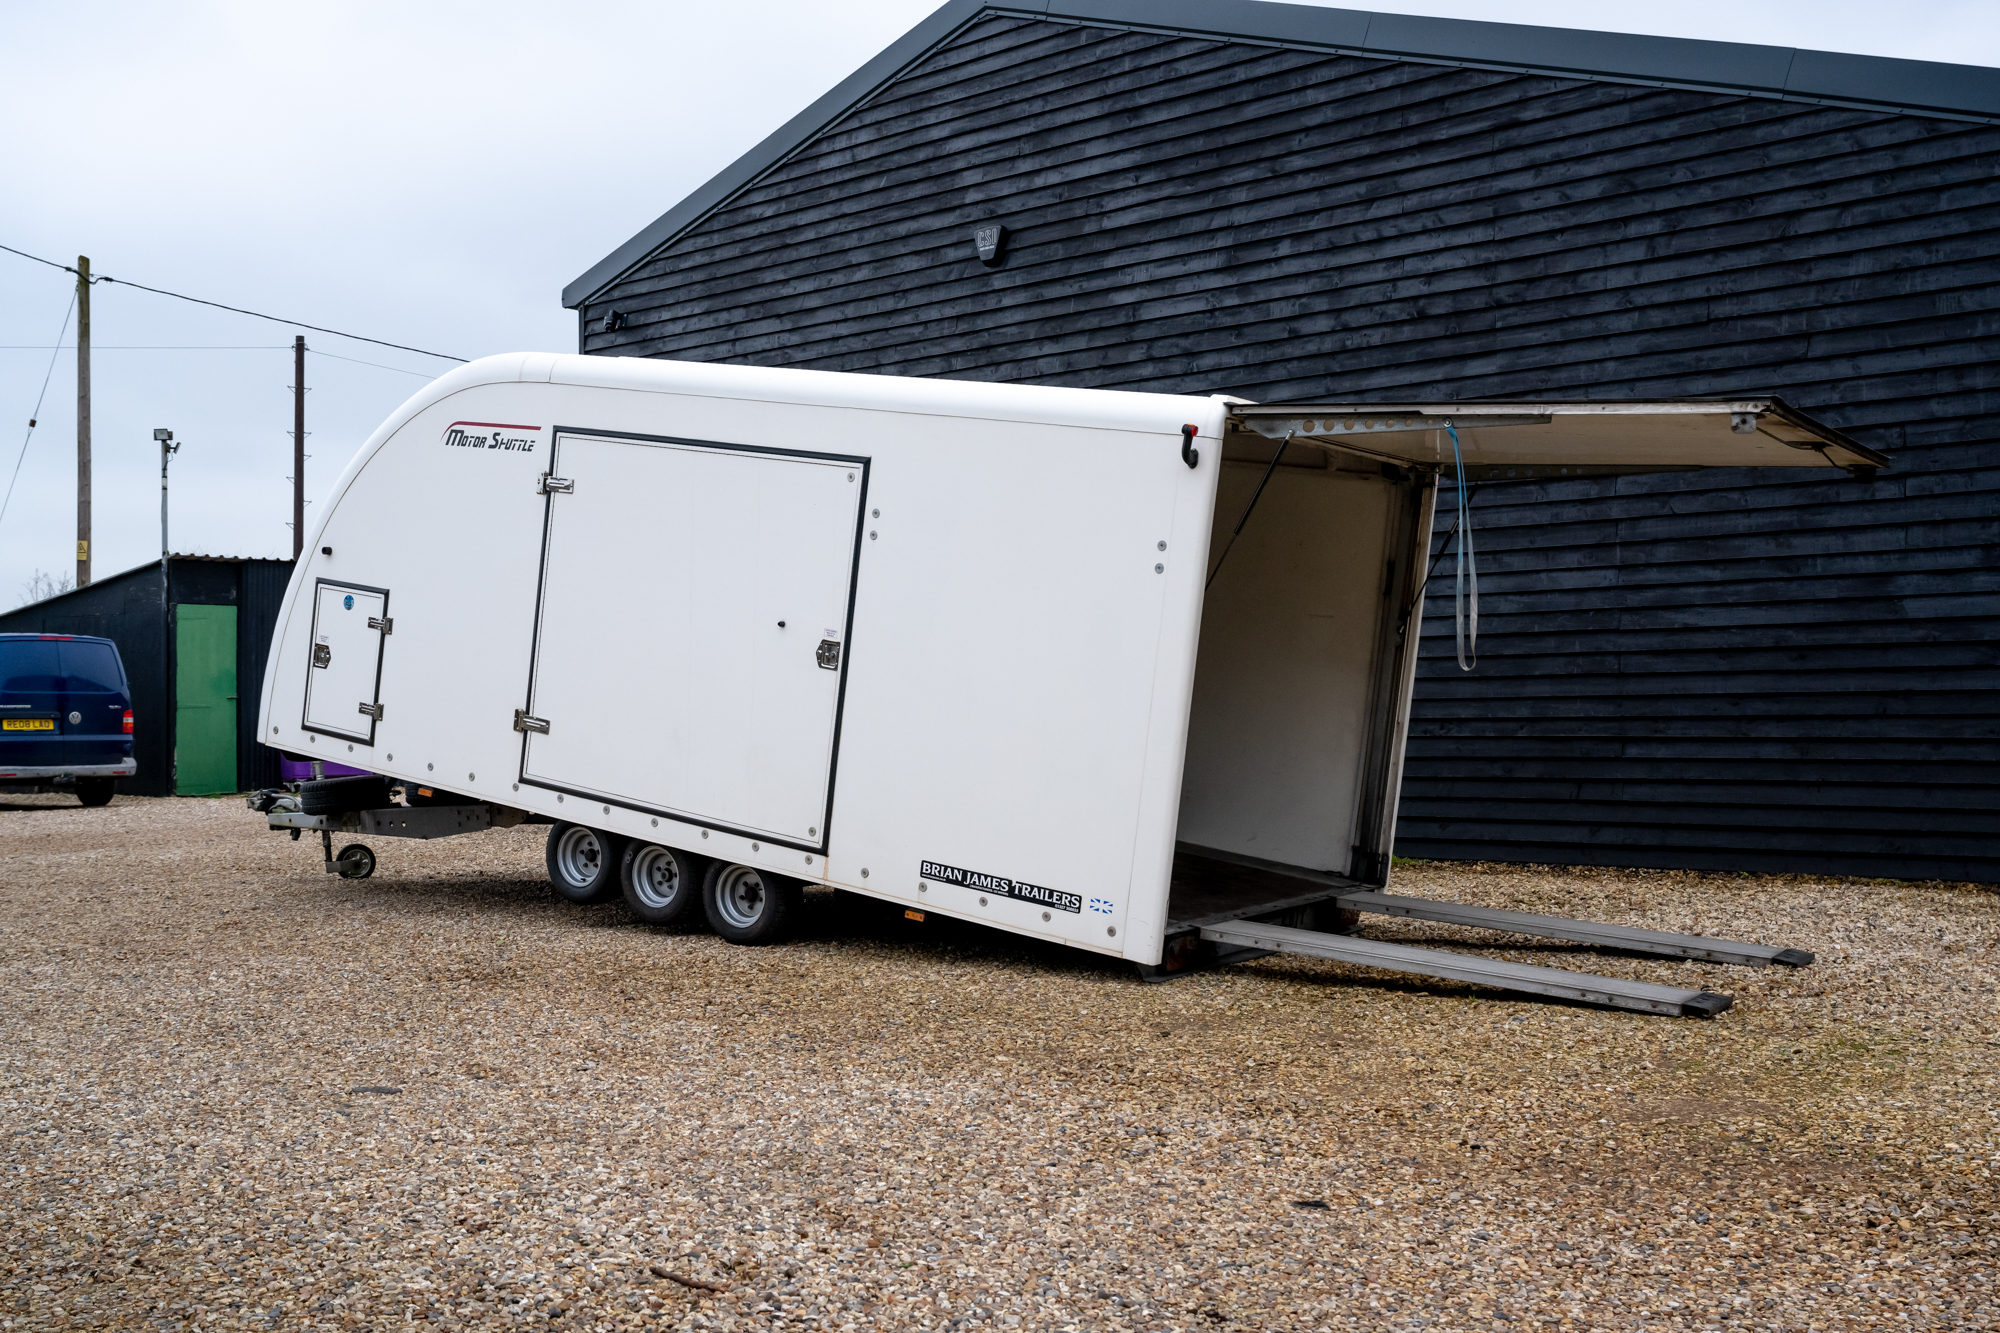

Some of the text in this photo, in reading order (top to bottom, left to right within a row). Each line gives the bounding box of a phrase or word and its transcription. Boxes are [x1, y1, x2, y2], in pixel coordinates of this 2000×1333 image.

[445, 429, 535, 452] MOTOR SHUTTLE
[6, 721, 30, 729] RE08
[922, 862, 963, 881] BRIAN
[963, 872, 1009, 892] JAMES
[1013, 882, 1080, 908] TRAILERS
